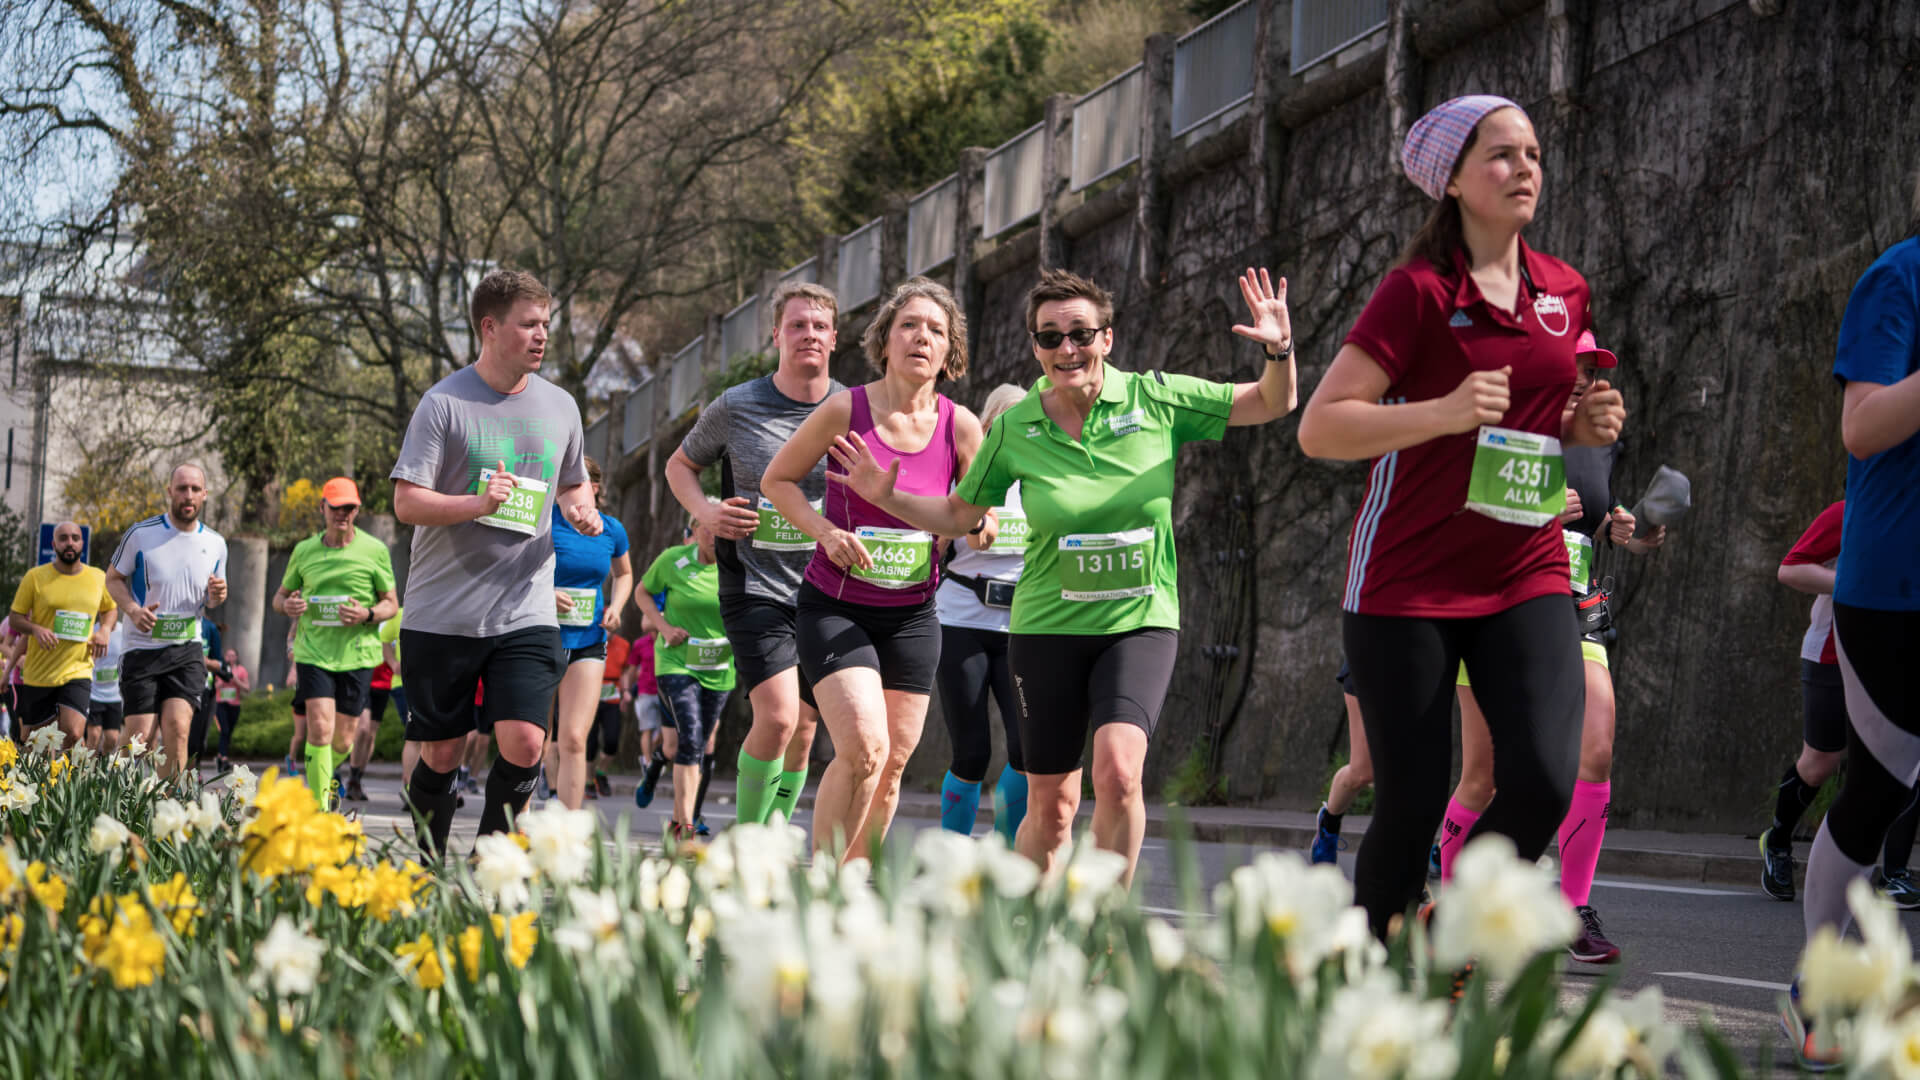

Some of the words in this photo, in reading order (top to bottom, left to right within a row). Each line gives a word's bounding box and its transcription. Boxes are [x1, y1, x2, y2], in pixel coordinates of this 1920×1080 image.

[1498, 458, 1551, 488] 4351
[504, 490, 534, 510] 238
[1503, 488, 1542, 505] ALVA
[775, 531, 803, 540] FELIX
[1000, 521, 1028, 536] 460
[871, 545, 916, 564] 4663
[1076, 550, 1144, 573] 13115
[871, 564, 912, 577] SABINE
[575, 599, 593, 610] 075
[162, 621, 187, 631] 5091
